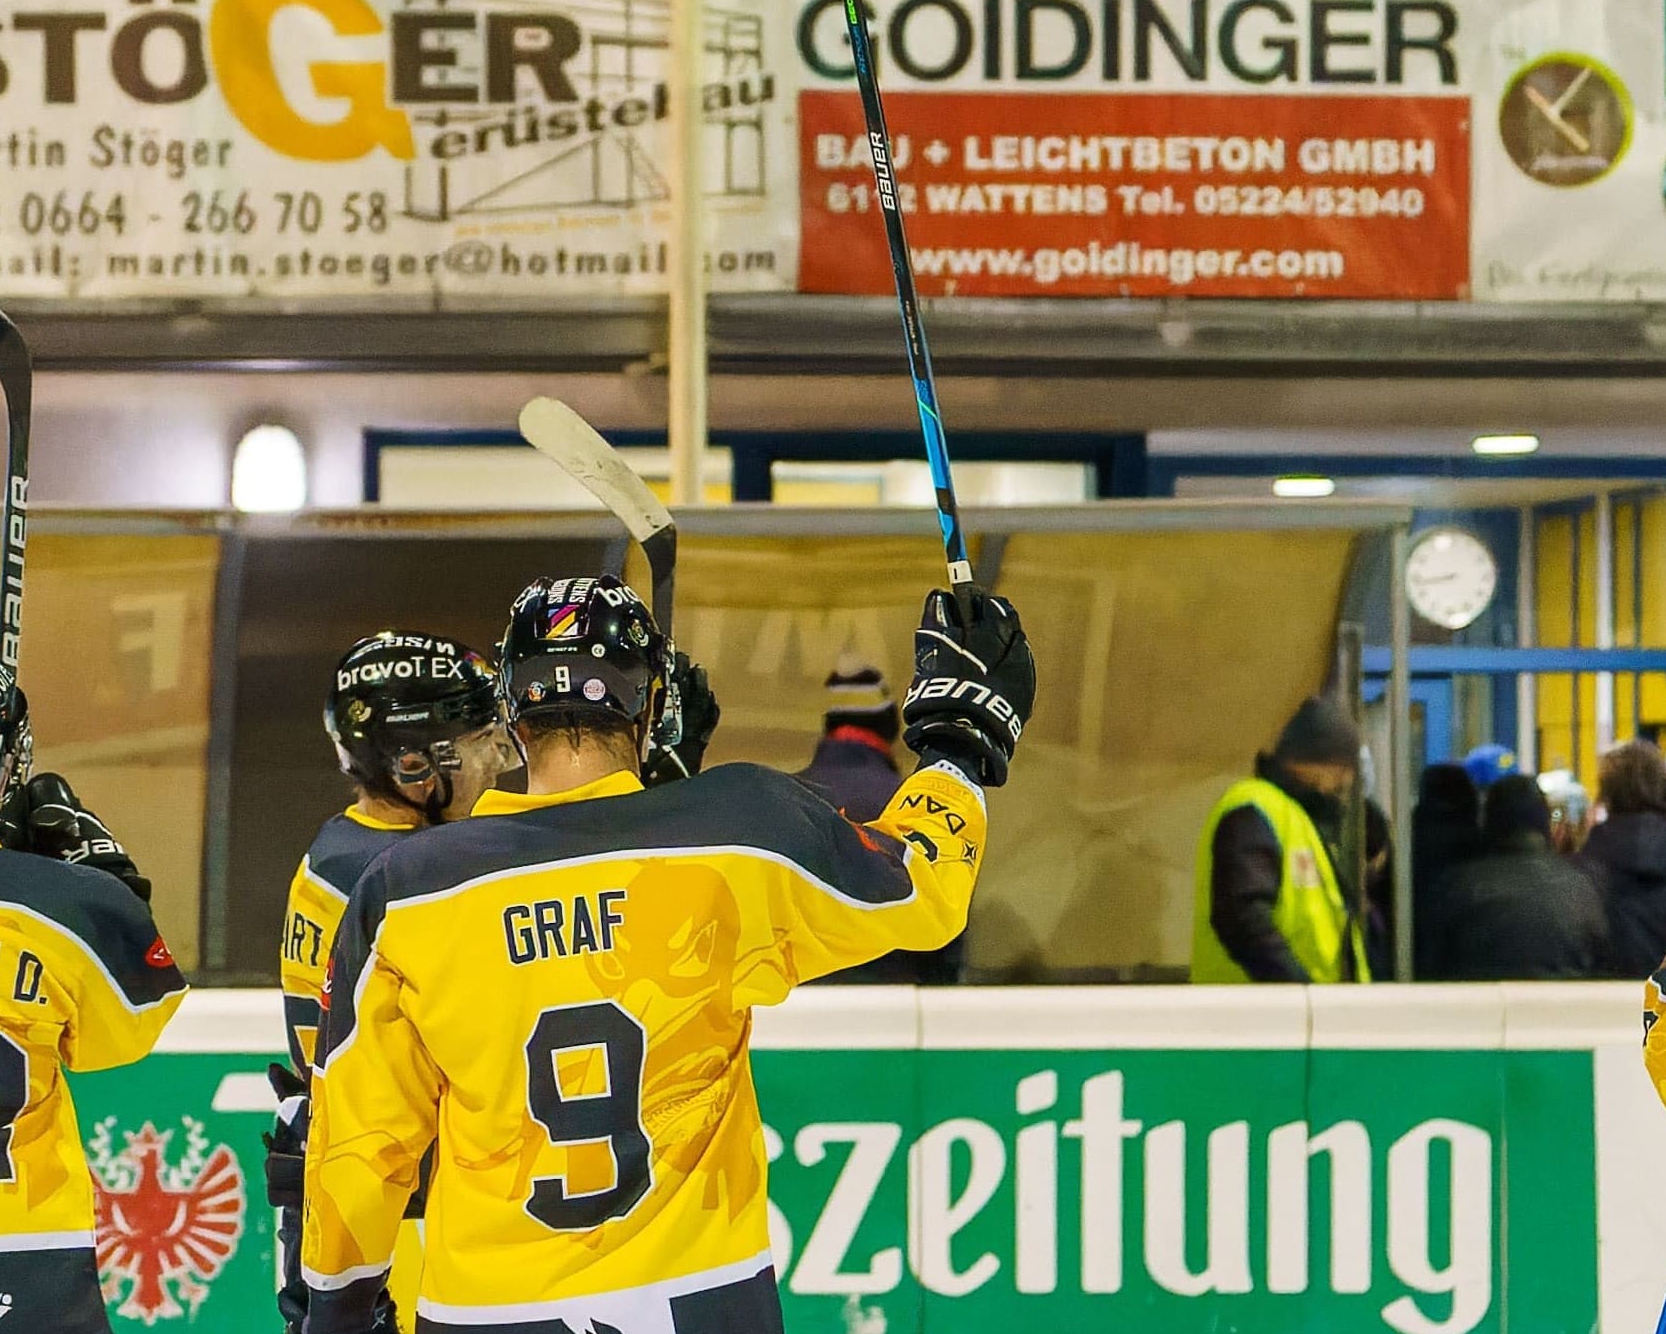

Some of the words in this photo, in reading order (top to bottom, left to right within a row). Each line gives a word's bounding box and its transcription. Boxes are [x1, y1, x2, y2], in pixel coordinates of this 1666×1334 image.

[89, 124, 233, 180] Stöger
[868, 130, 896, 212] BAUER
[965, 134, 1286, 172] LEICHTBETON
[1299, 137, 1435, 175] GMBH
[19, 189, 128, 238] 0664
[181, 190, 258, 236] 266
[273, 191, 324, 236] 70
[343, 192, 389, 236] 58
[926, 183, 1109, 215] WATTENS
[1117, 185, 1184, 217] Tel.
[910, 242, 1346, 284] www.goidinger.com
[1, 473, 31, 667] BAUER
[337, 655, 464, 692] bravoTEX
[555, 665, 571, 693] 9
[903, 677, 1023, 744] BAUER
[503, 889, 628, 966] GRAF
[14, 951, 48, 1005] D.
[523, 999, 655, 1234] 9
